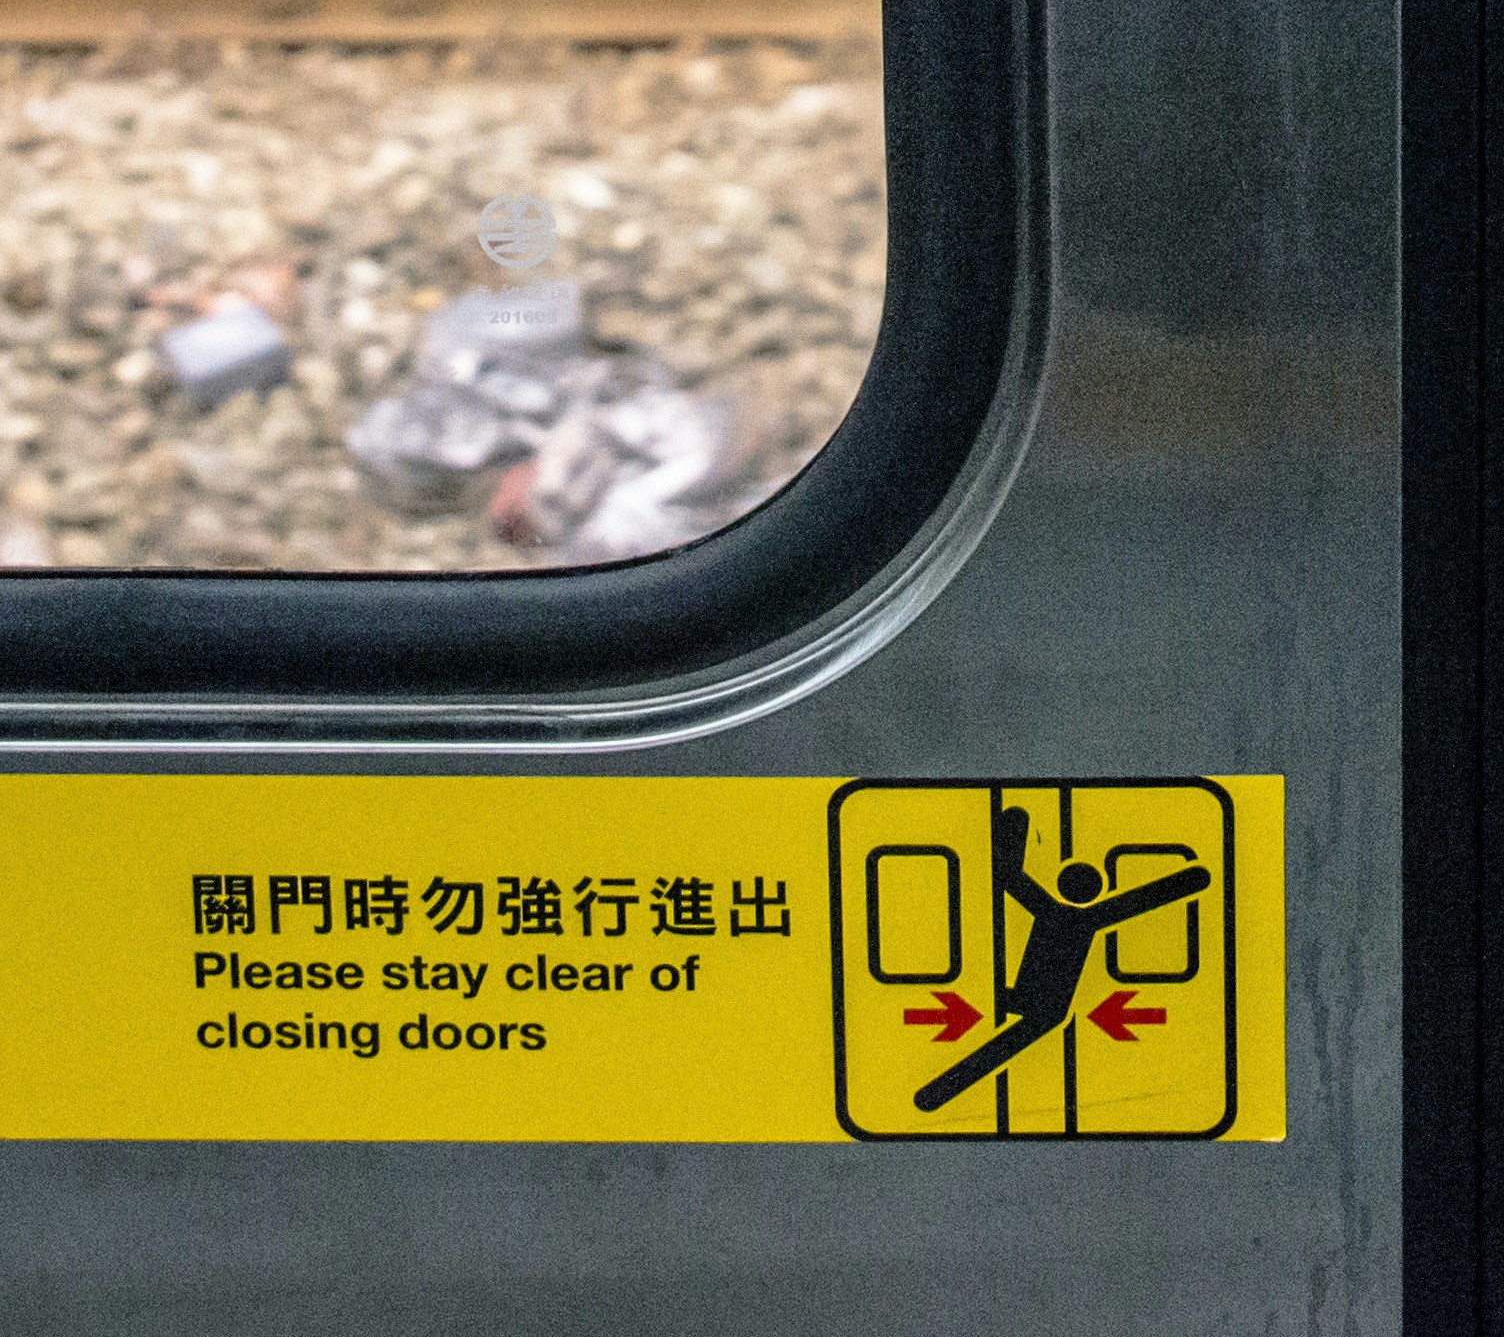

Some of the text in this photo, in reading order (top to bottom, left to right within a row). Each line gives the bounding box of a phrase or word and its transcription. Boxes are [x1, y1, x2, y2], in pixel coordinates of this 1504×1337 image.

[191, 874, 792, 938] 關門時勿強行進出
[194, 951, 701, 1000] Please stay clear of
[196, 1012, 547, 1059] closing doors
